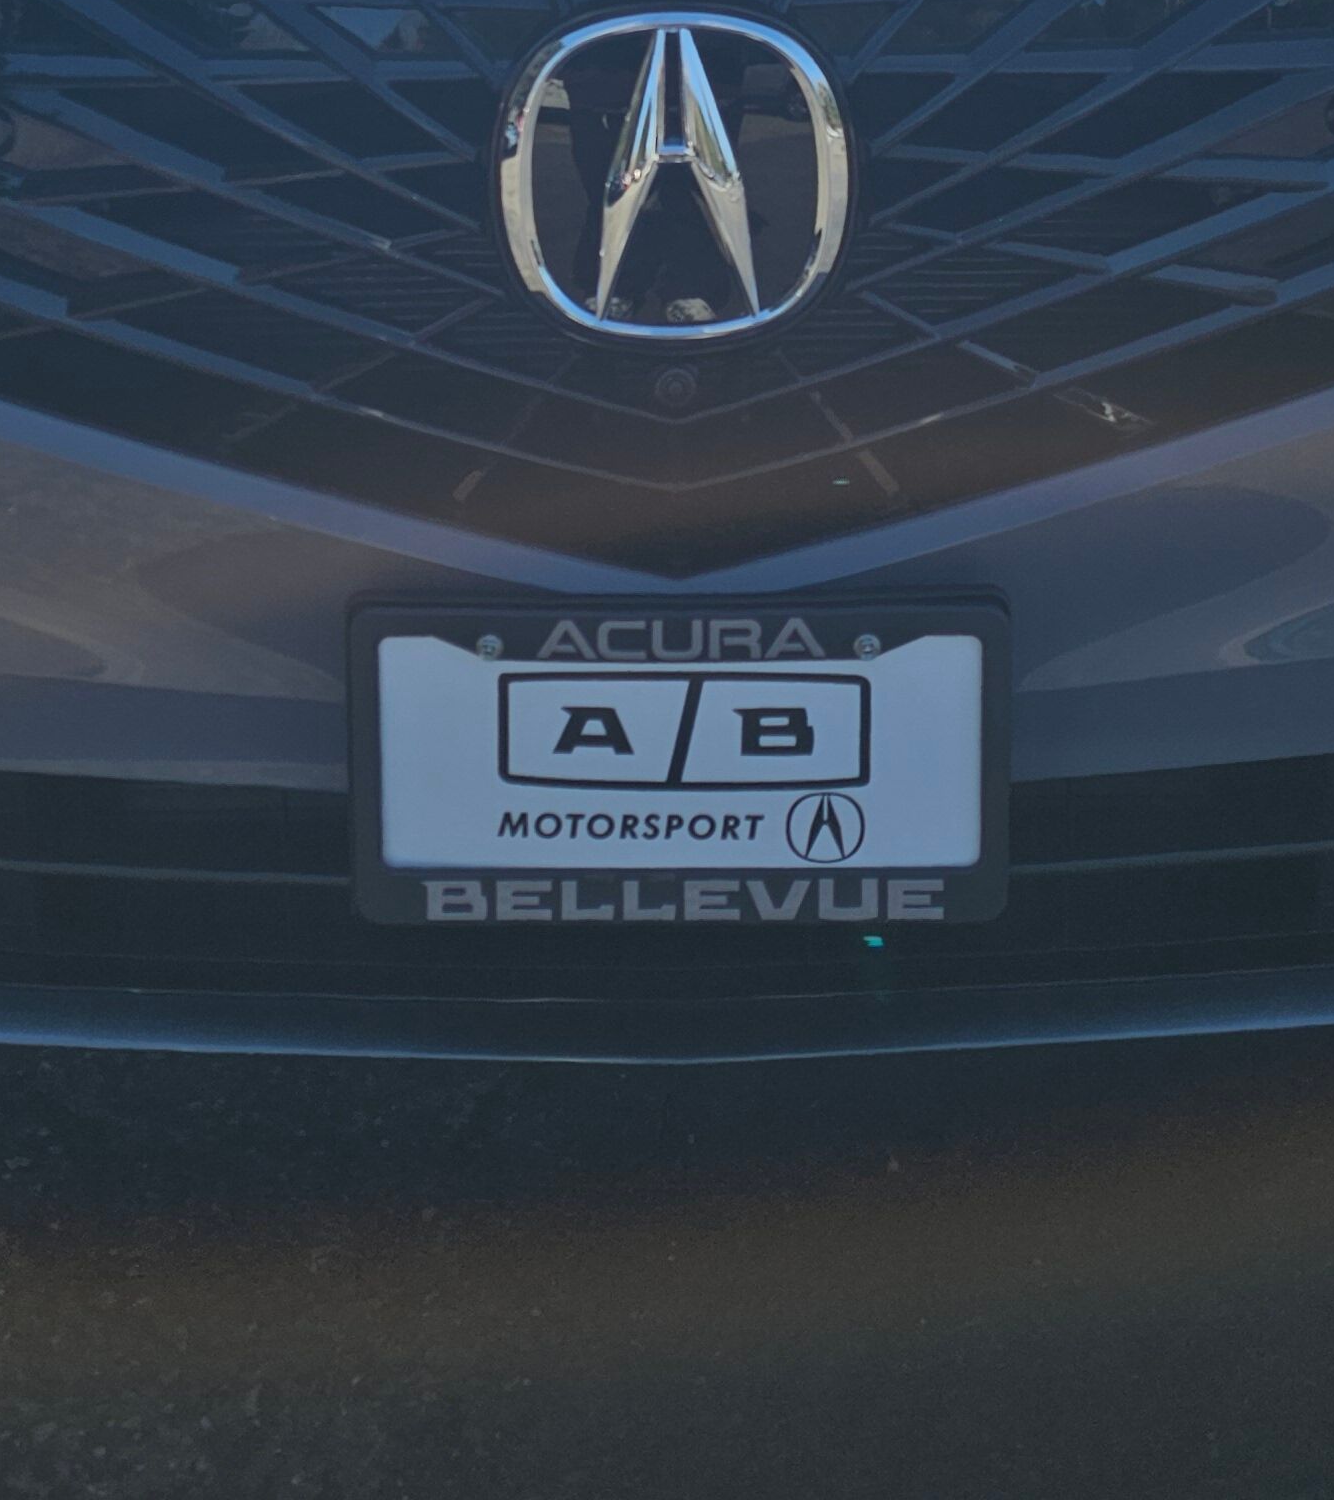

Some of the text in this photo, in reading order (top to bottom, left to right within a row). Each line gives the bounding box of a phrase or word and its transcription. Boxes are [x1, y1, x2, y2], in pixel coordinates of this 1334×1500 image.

[538, 617, 825, 660] ACURA
[553, 706, 815, 756] A B
[497, 811, 765, 841] MOTORSPORT
[422, 878, 944, 921] BELLEVUE
